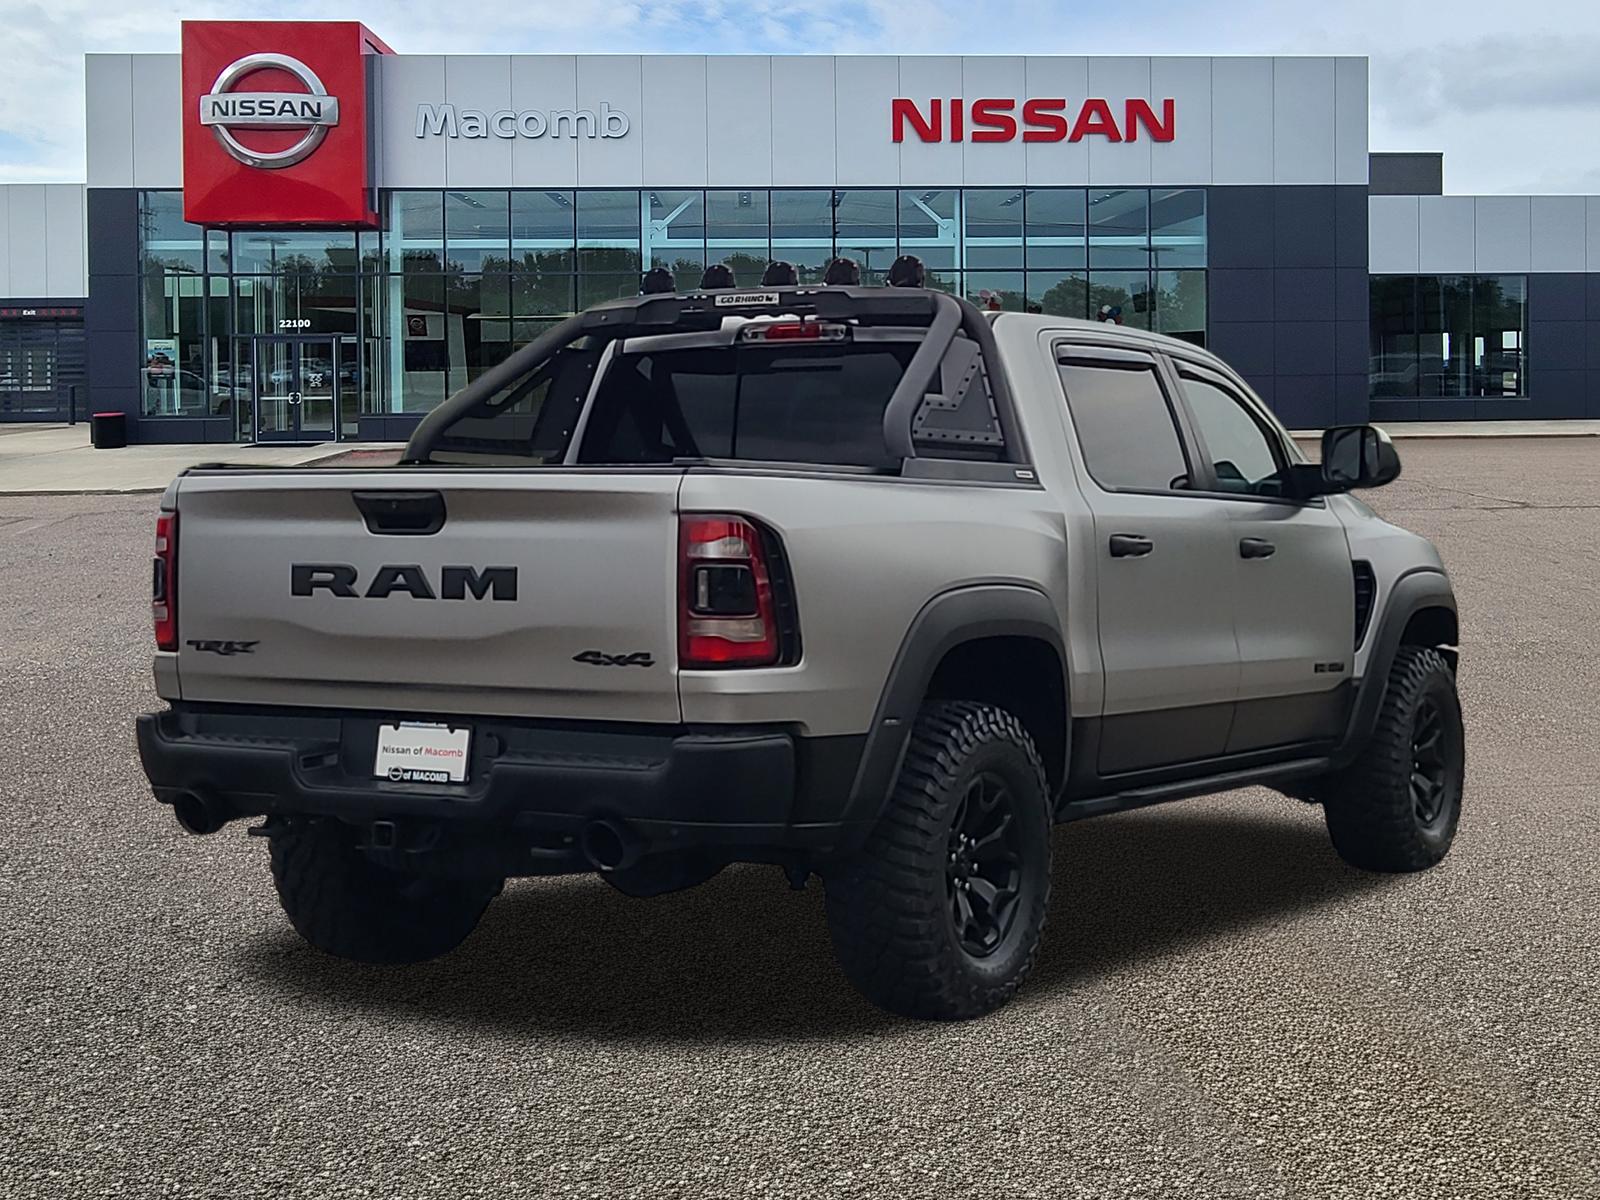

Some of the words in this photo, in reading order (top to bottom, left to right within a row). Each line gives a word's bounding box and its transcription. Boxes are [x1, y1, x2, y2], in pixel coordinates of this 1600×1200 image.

[212, 100, 322, 118] NISSAN
[415, 102, 630, 139] Macomb
[892, 98, 1175, 143] NISSAN
[720, 296, 734, 304] GO
[735, 295, 764, 303] RHINO
[279, 319, 311, 328] 22100
[291, 563, 518, 601] RAM
[572, 651, 656, 667] 4x4
[382, 745, 411, 755] Nissan
[413, 746, 422, 755] of
[424, 747, 463, 758] Macomb
[403, 770, 412, 780] of
[412, 771, 448, 782] MACOMB
